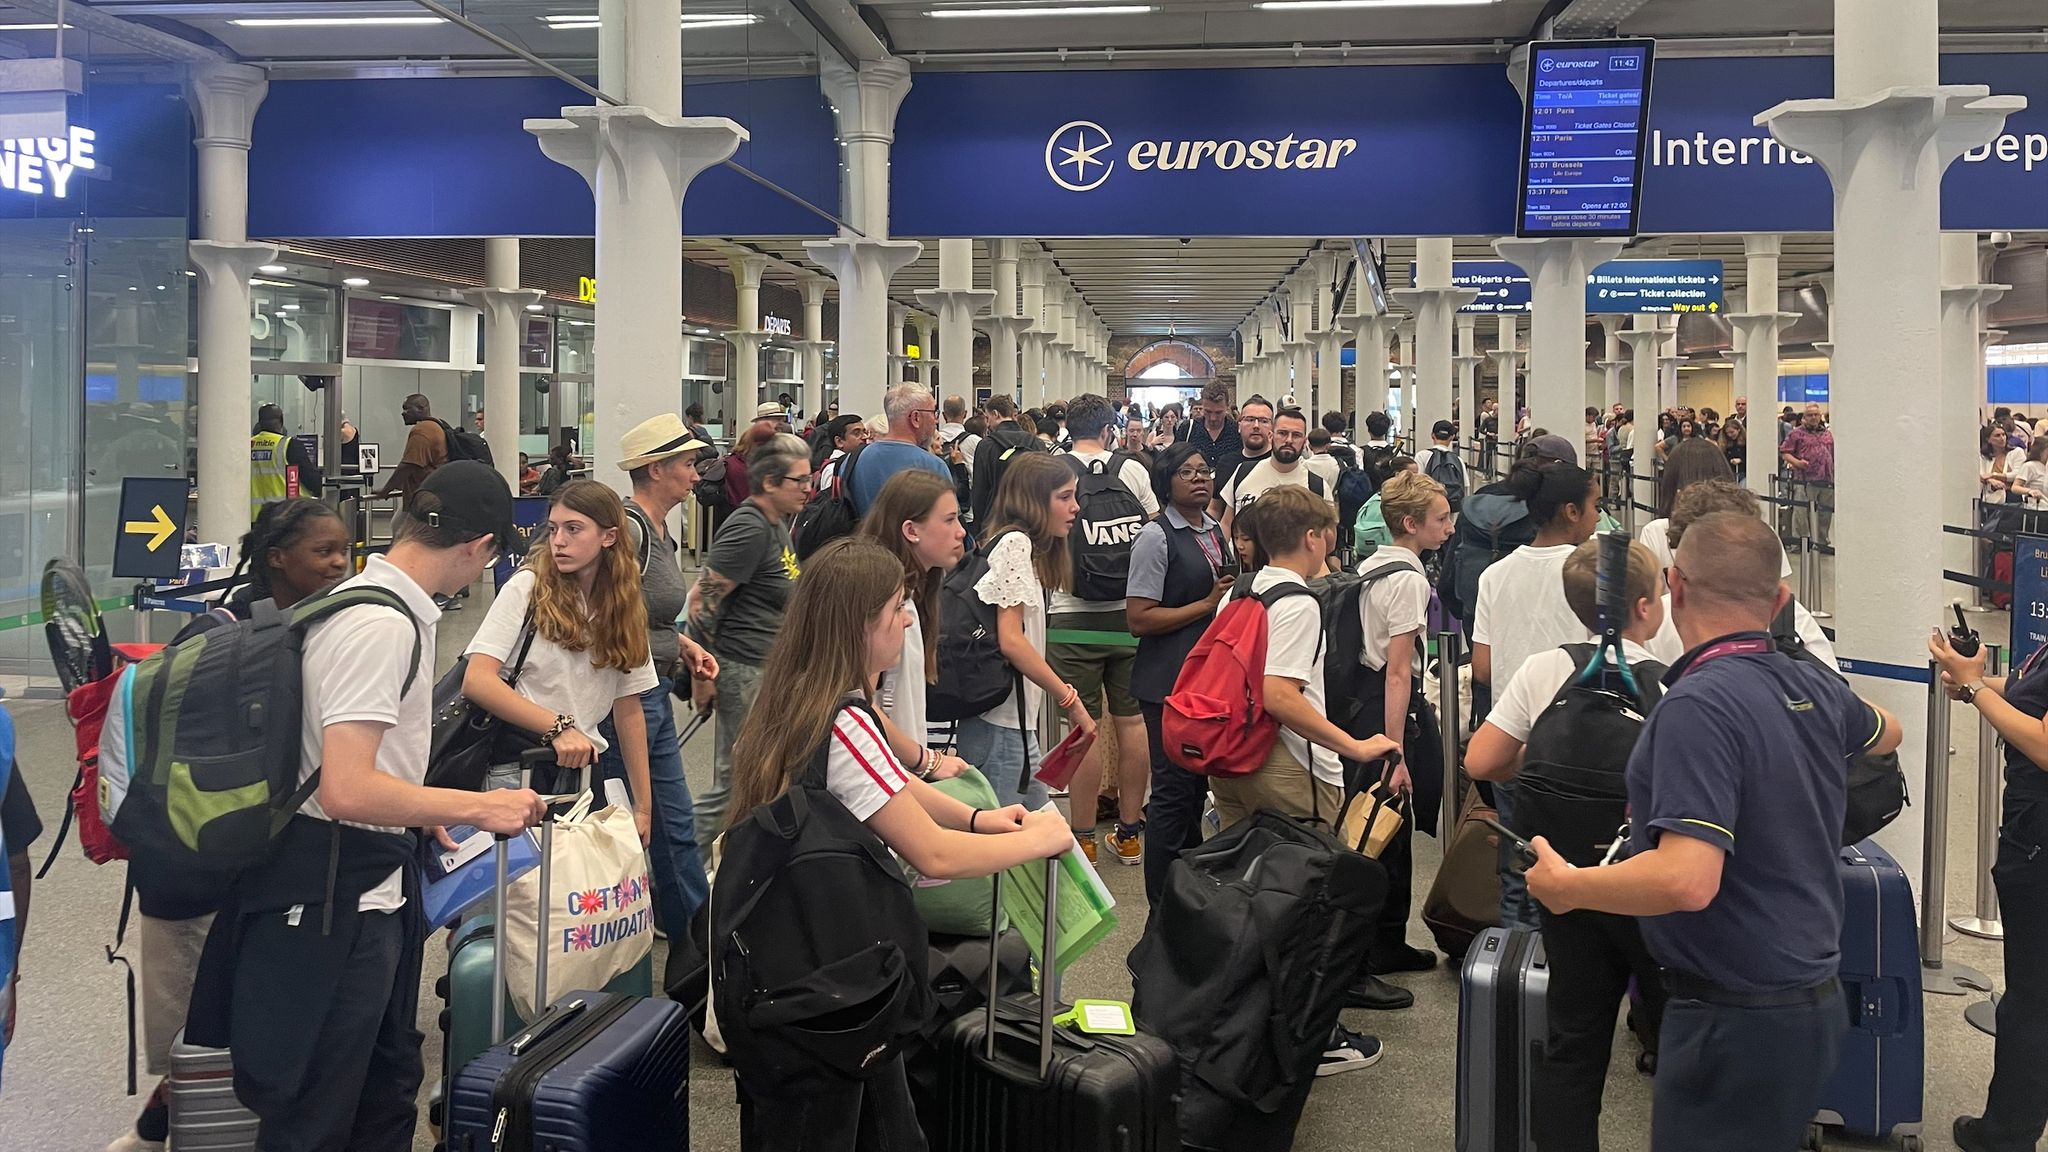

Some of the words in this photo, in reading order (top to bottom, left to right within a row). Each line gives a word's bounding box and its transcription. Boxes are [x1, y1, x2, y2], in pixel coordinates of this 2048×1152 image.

[1556, 60, 1599, 69] eurostar
[1539, 79, 1603, 88] Departures/départs
[1127, 132, 1357, 171] eurostar
[1581, 202, 1602, 210] Opens
[1471, 275, 1503, 285] Départs
[1597, 275, 1623, 284] Billets
[1624, 275, 1676, 284] International
[1678, 275, 1706, 284] tickets
[1639, 289, 1664, 298] Ticket
[1666, 289, 1706, 298] collection
[1673, 303, 1690, 313] Way
[1692, 303, 1706, 312] out
[1082, 515, 1142, 545] VANS
[2029, 632, 2046, 642] TRAIN
